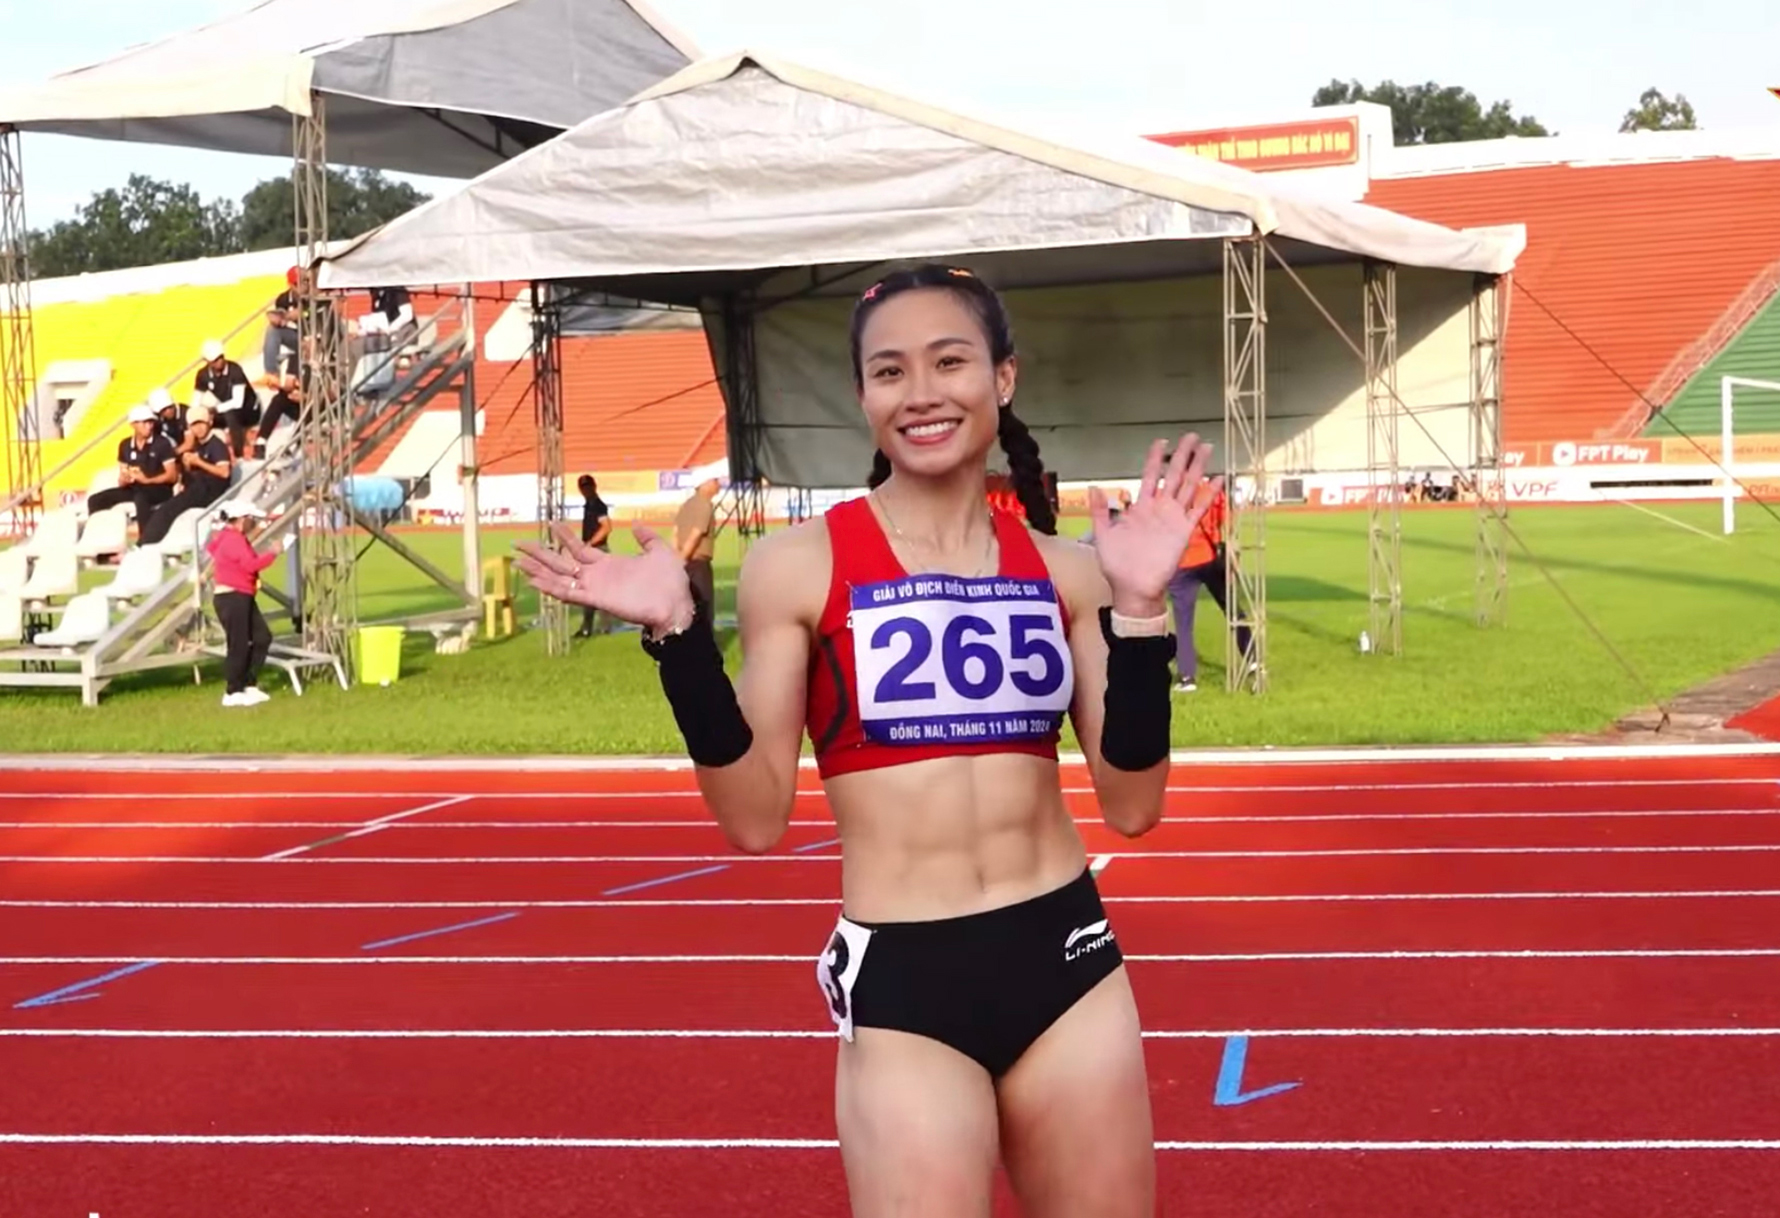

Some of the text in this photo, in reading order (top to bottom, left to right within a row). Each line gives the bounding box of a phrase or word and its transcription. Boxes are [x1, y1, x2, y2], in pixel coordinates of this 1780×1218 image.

[1578, 445, 1609, 461] FPT
[1612, 444, 1649, 463] Play
[1512, 481, 1557, 498] VPF
[915, 581, 943, 598] ĐỊCH
[965, 584, 993, 598] KINH
[1022, 584, 1040, 596] GIA
[871, 614, 1065, 703] 265
[924, 723, 947, 739] NAI,
[949, 719, 986, 737] THÁNG
[989, 721, 1002, 735] 11
